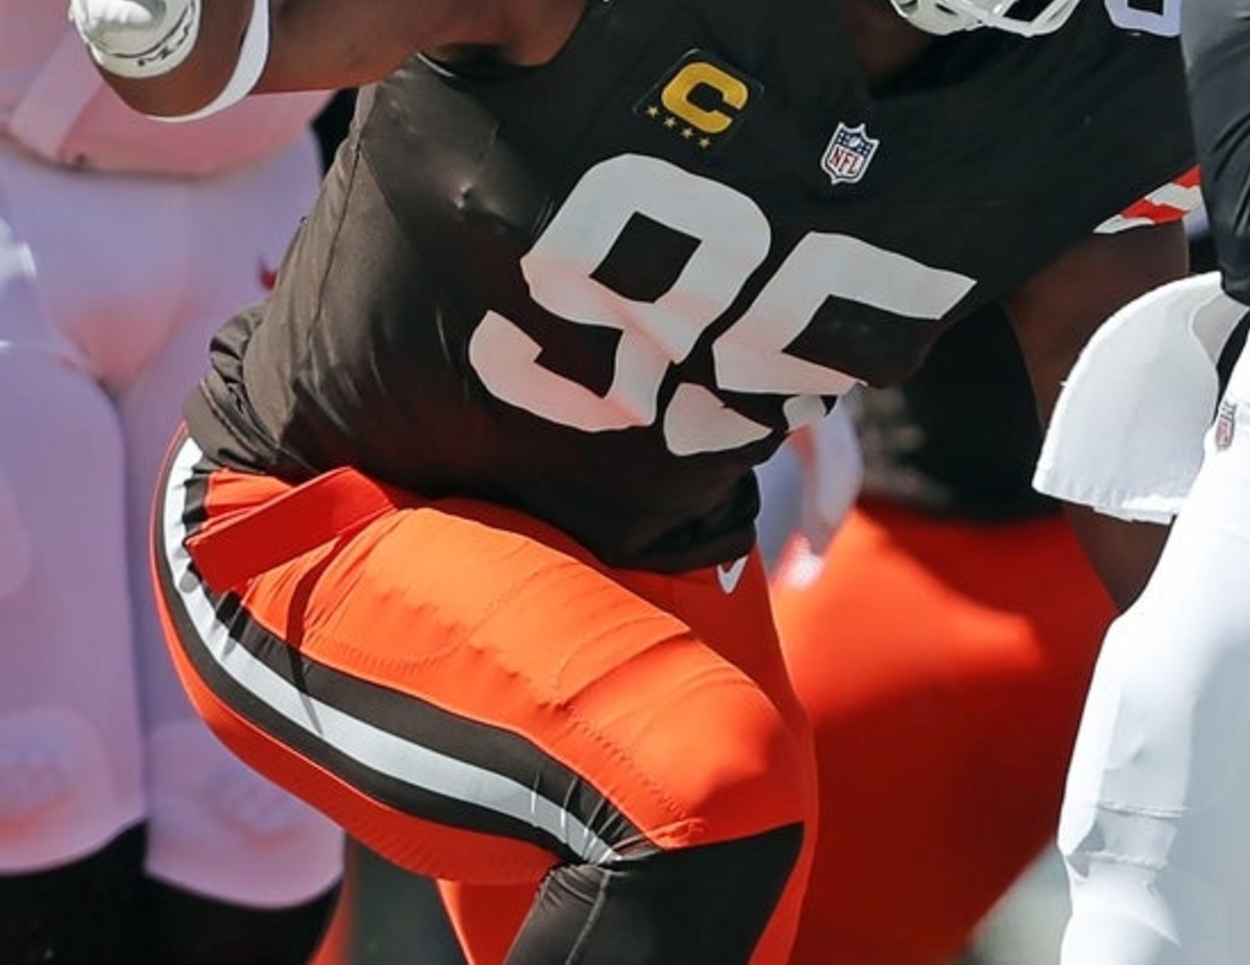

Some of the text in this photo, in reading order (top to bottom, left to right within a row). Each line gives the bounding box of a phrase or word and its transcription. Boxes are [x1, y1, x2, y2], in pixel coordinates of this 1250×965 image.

[660, 61, 749, 134] C
[828, 144, 864, 176] NFL
[467, 152, 978, 457] 95
